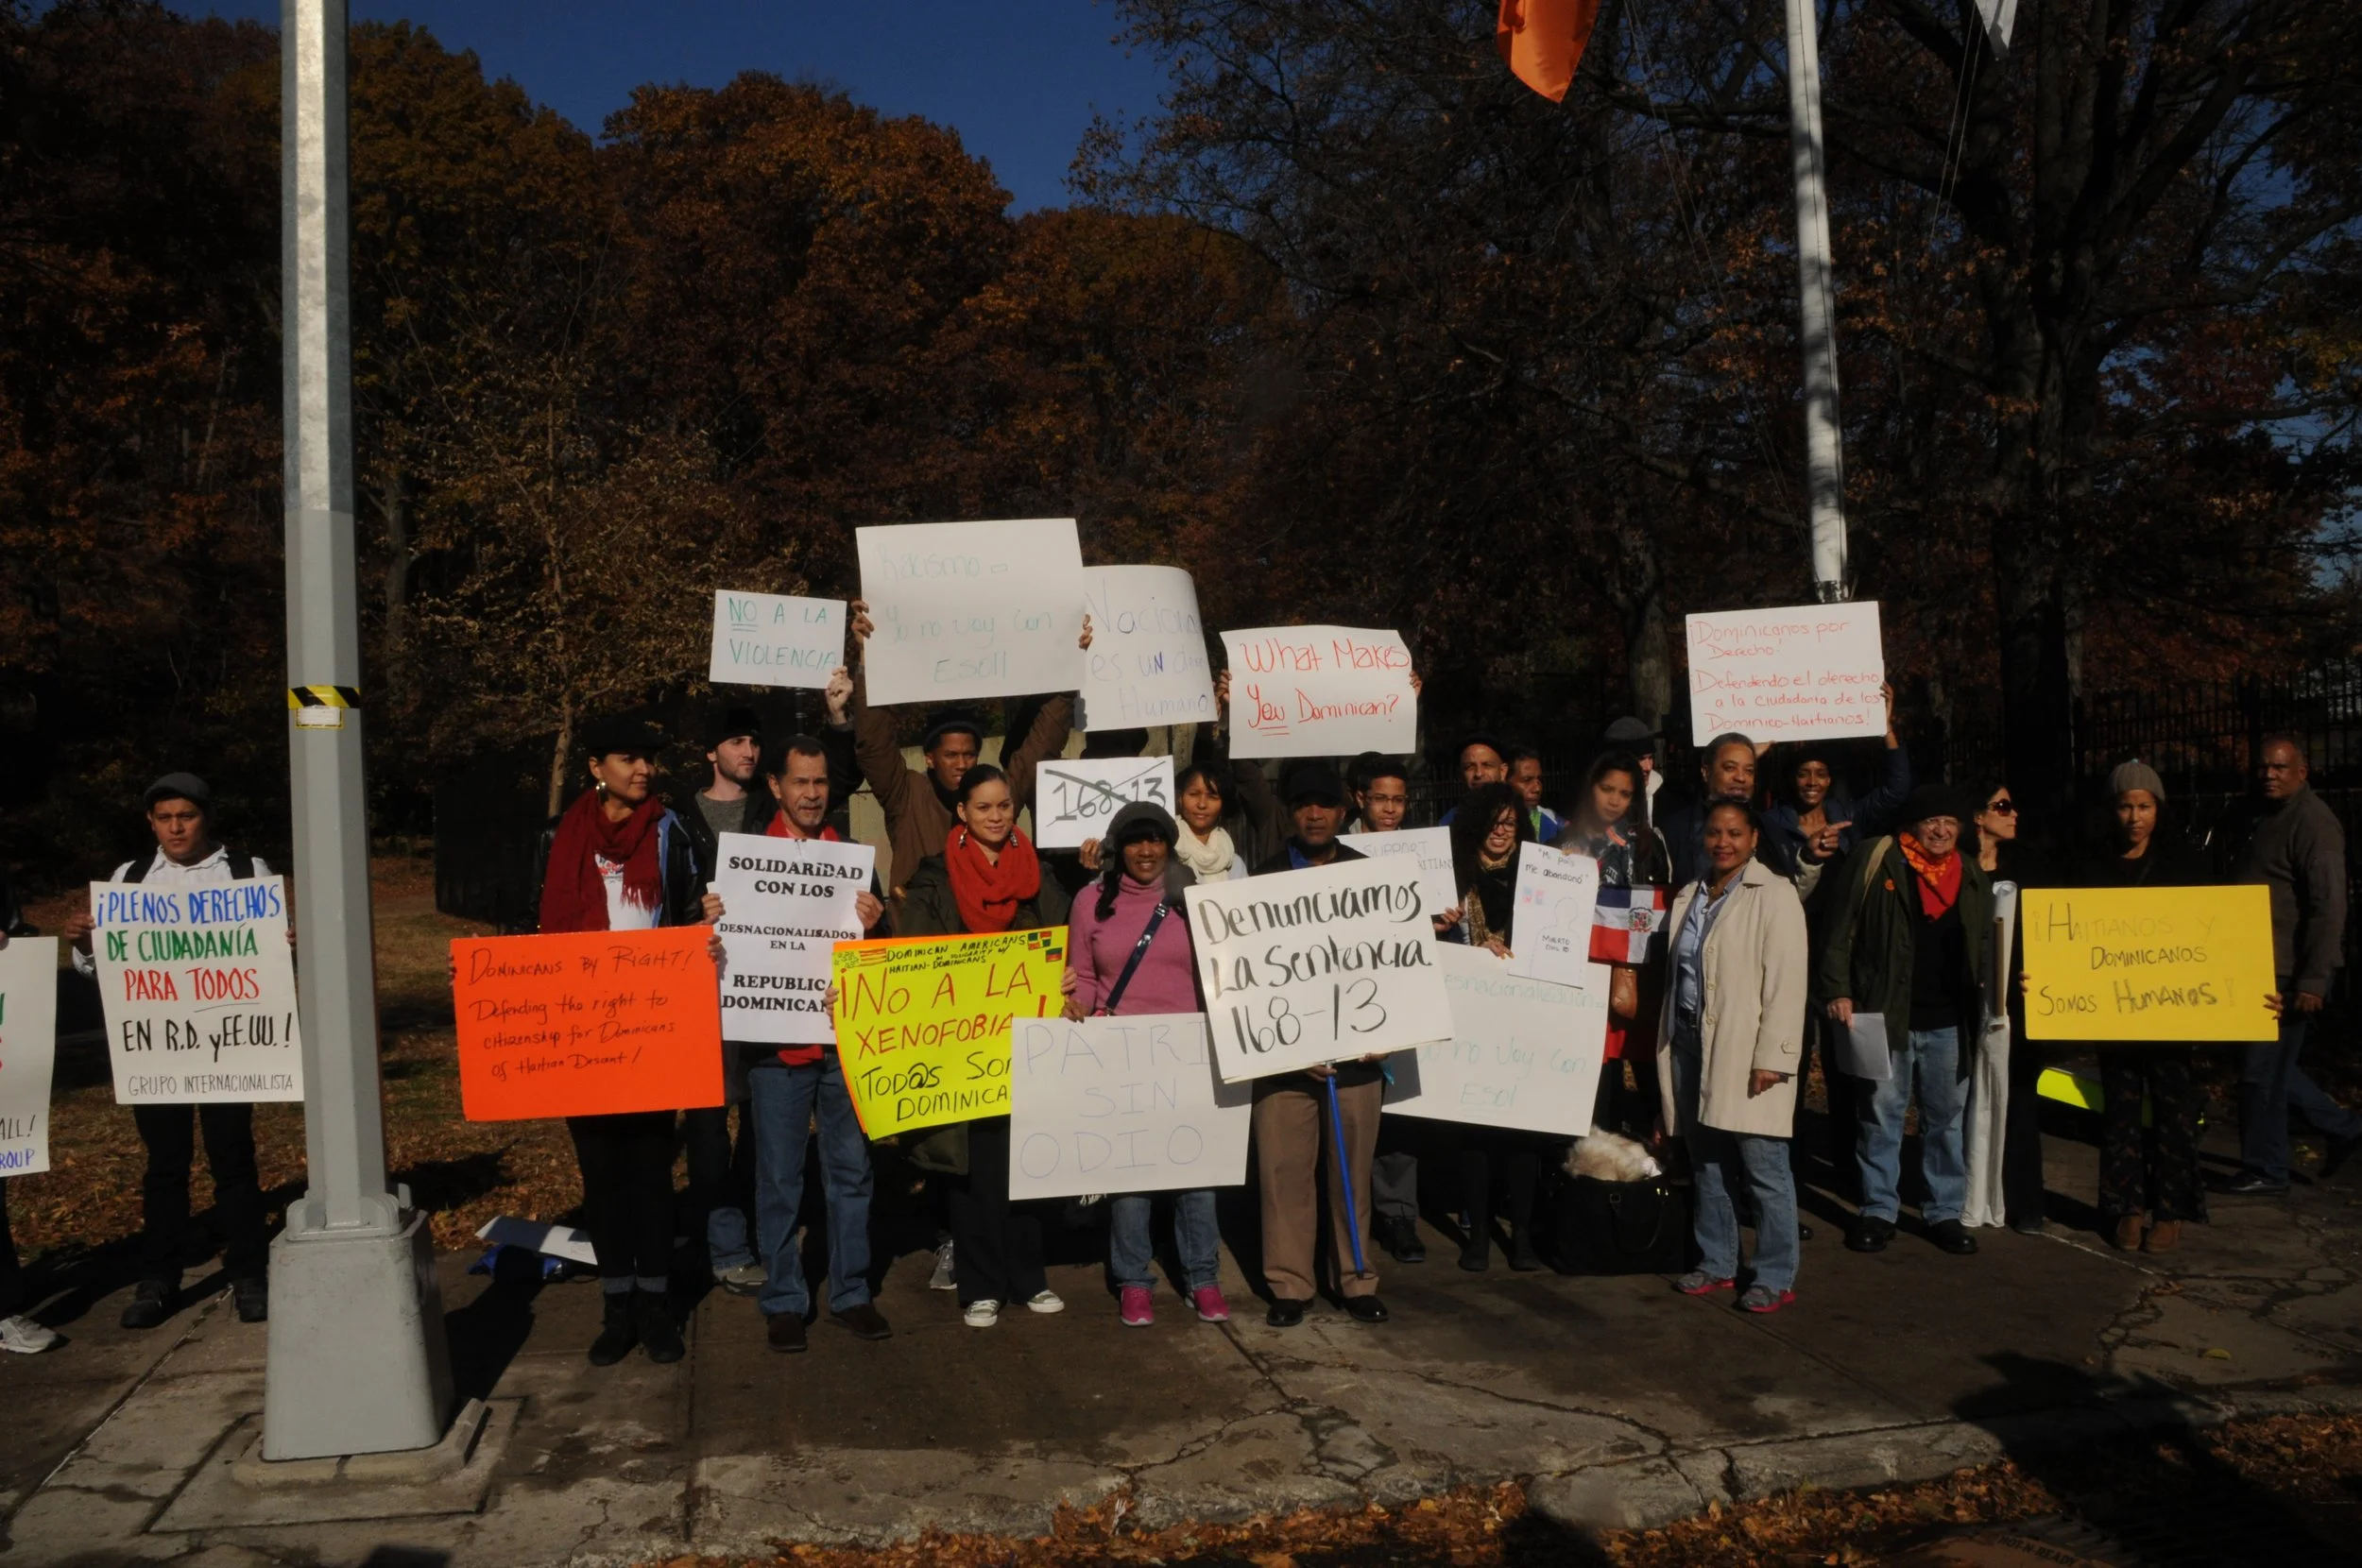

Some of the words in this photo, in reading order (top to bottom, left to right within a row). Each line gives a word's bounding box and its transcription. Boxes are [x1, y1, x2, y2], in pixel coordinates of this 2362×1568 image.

[728, 597, 757, 622] NO
[774, 603, 785, 624] A
[804, 607, 827, 623] LA
[1816, 622, 1850, 642] por
[729, 638, 837, 673] VIOLENCIA
[1240, 638, 1322, 673] What
[1793, 670, 1811, 686] el
[1818, 671, 1879, 687] derecho
[1246, 684, 1286, 728] You
[1294, 688, 1398, 724] Dominican?
[1715, 698, 1724, 707] a
[1732, 694, 1746, 707] la
[1834, 692, 1856, 705] de
[1861, 692, 1880, 704] los
[728, 856, 864, 880] SOLIDARIDAD
[754, 879, 796, 895] CON
[799, 883, 834, 897] LOS
[97, 891, 180, 927] ¡PLENOS
[189, 884, 281, 925] DERECHOS
[1197, 880, 1421, 945] Denunciamos
[107, 930, 129, 962] DE
[138, 922, 259, 962] CIUDADANÍA
[719, 923, 857, 940] DESNACIONALISADOS
[770, 940, 787, 950] EN
[791, 942, 806, 951] LA
[886, 945, 949, 963] DOMINICAN
[960, 934, 1027, 952] AMERICANS
[469, 947, 562, 985] DOMINICANS
[581, 956, 597, 978] BY
[1210, 955, 1259, 1000] La
[1264, 934, 1432, 987] Sentencia
[2091, 946, 2207, 970] DOMINICANOS
[124, 968, 179, 1001] PARA
[185, 967, 260, 1000] TODOS
[931, 973, 955, 1009] A
[985, 962, 1033, 997] LA
[2037, 985, 2097, 1015] SOMOS
[469, 999, 548, 1025] Defending
[556, 994, 583, 1013] the
[592, 991, 636, 1018] right
[646, 990, 668, 1008] to
[1231, 978, 1387, 1054] 168-13
[122, 1018, 152, 1052] EN
[165, 1019, 201, 1051] R.D.
[568, 1026, 593, 1046] for
[598, 1020, 675, 1043] Dominicans
[1025, 1019, 1209, 1075] PATRI
[515, 1056, 564, 1074] Haitian
[128, 1076, 177, 1096] GRUPO
[184, 1074, 294, 1095] INTERNACIONALISTA
[1079, 1076, 1177, 1117] SIN
[897, 1084, 1012, 1122] DOMINICA
[0, 1149, 35, 1169] ROUP
[1019, 1124, 1204, 1179] ODIO
